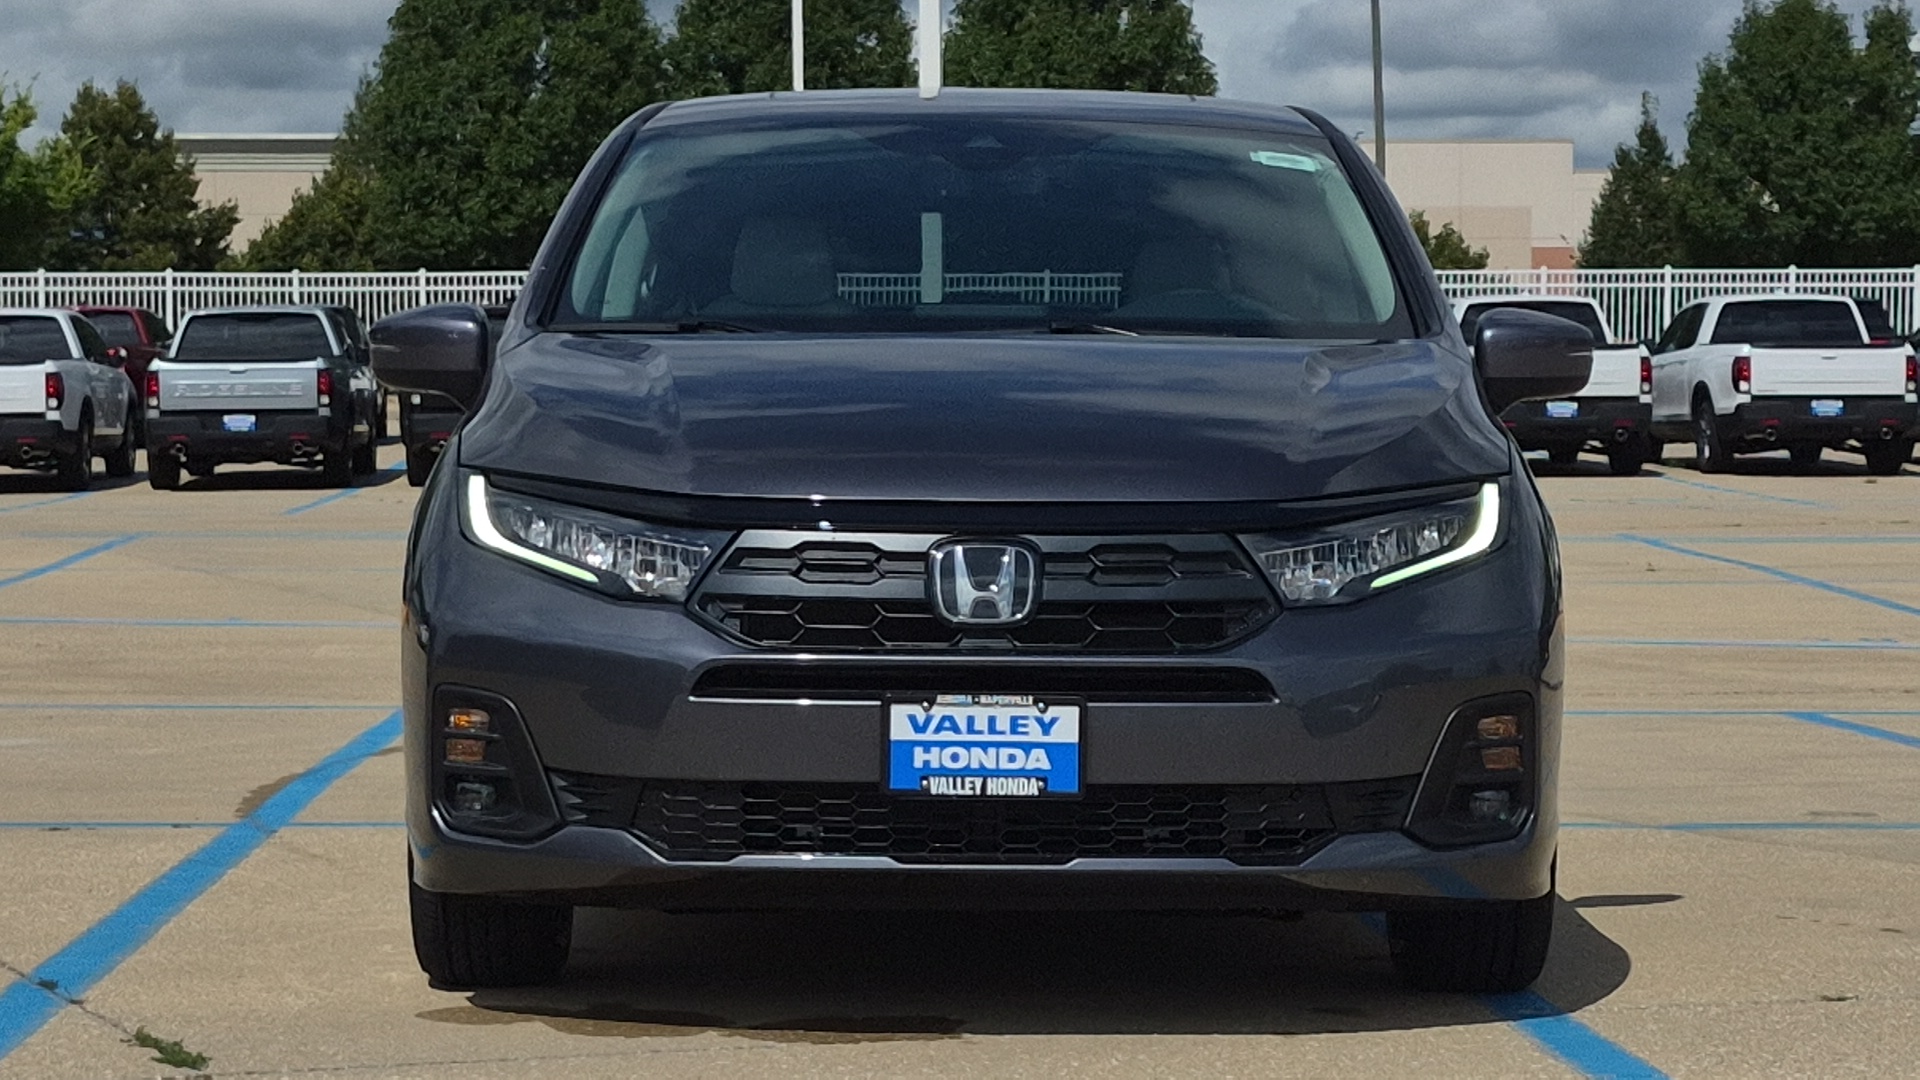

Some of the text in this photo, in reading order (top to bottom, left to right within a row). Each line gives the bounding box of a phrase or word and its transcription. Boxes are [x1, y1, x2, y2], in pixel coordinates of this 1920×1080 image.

[906, 713, 1060, 737] VALLEY
[912, 746, 1052, 771] HONDA
[929, 776, 1040, 796] VALLEY HONDA
